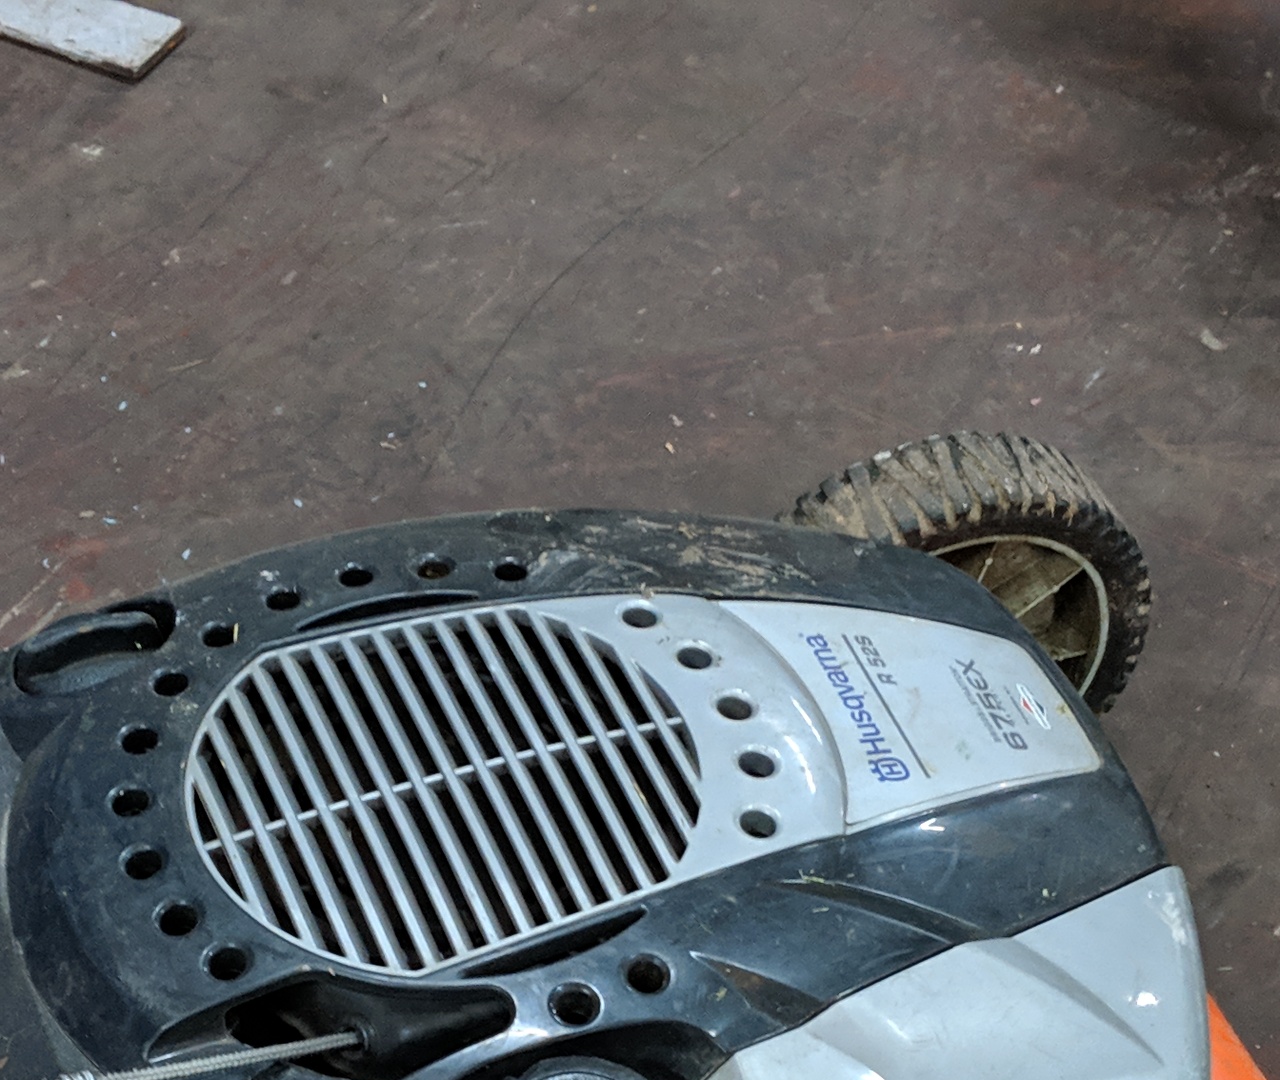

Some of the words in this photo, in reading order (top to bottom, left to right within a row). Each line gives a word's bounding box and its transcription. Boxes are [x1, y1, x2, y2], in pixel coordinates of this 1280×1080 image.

[854, 635, 886, 668] 52S
[877, 673, 898, 686] R
[806, 633, 891, 756] Husqvarna
[955, 658, 1028, 750] 675EX
